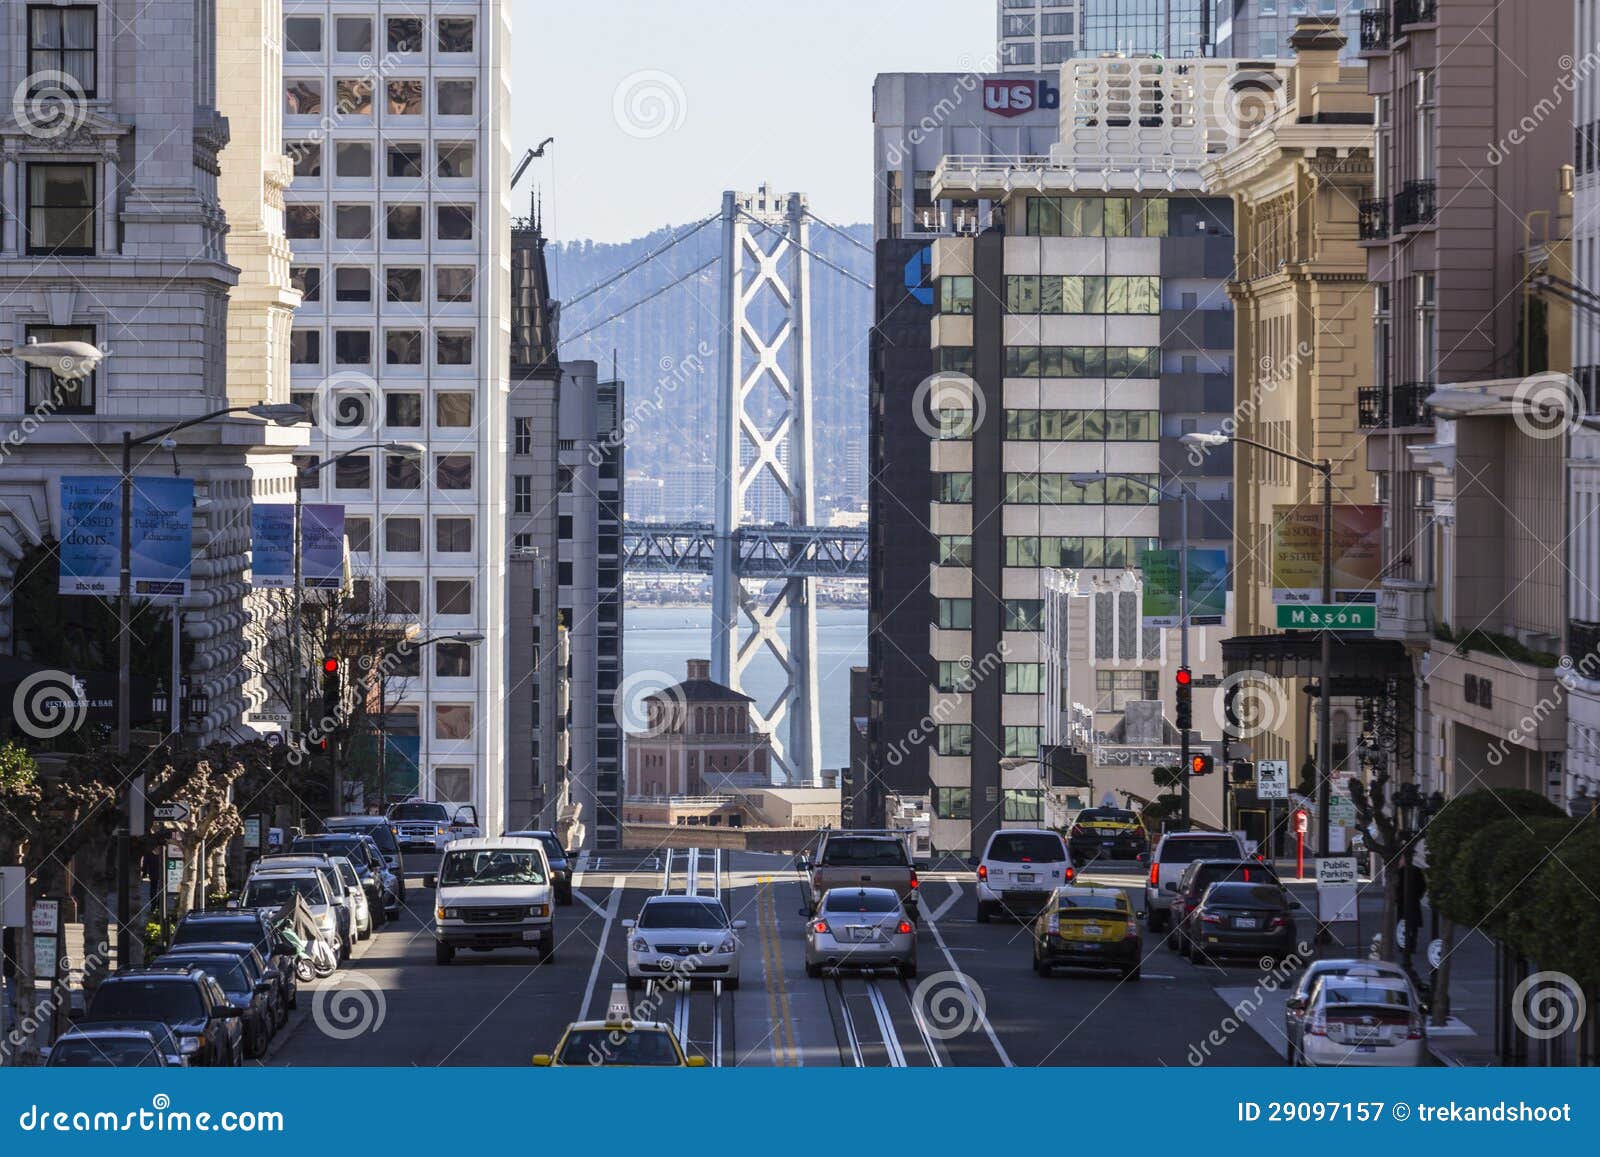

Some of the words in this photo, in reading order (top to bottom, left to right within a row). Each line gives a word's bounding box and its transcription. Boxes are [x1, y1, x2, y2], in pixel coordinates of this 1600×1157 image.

[67, 516, 114, 527] CLOSED
[1291, 610, 1361, 624] Mason
[45, 700, 89, 708] RESTAURANT
[1260, 782, 1270, 790] DO
[1272, 782, 1286, 790] NOT
[158, 808, 174, 816] PAY
[1323, 861, 1350, 870] Public
[1320, 870, 1354, 879] Parking
